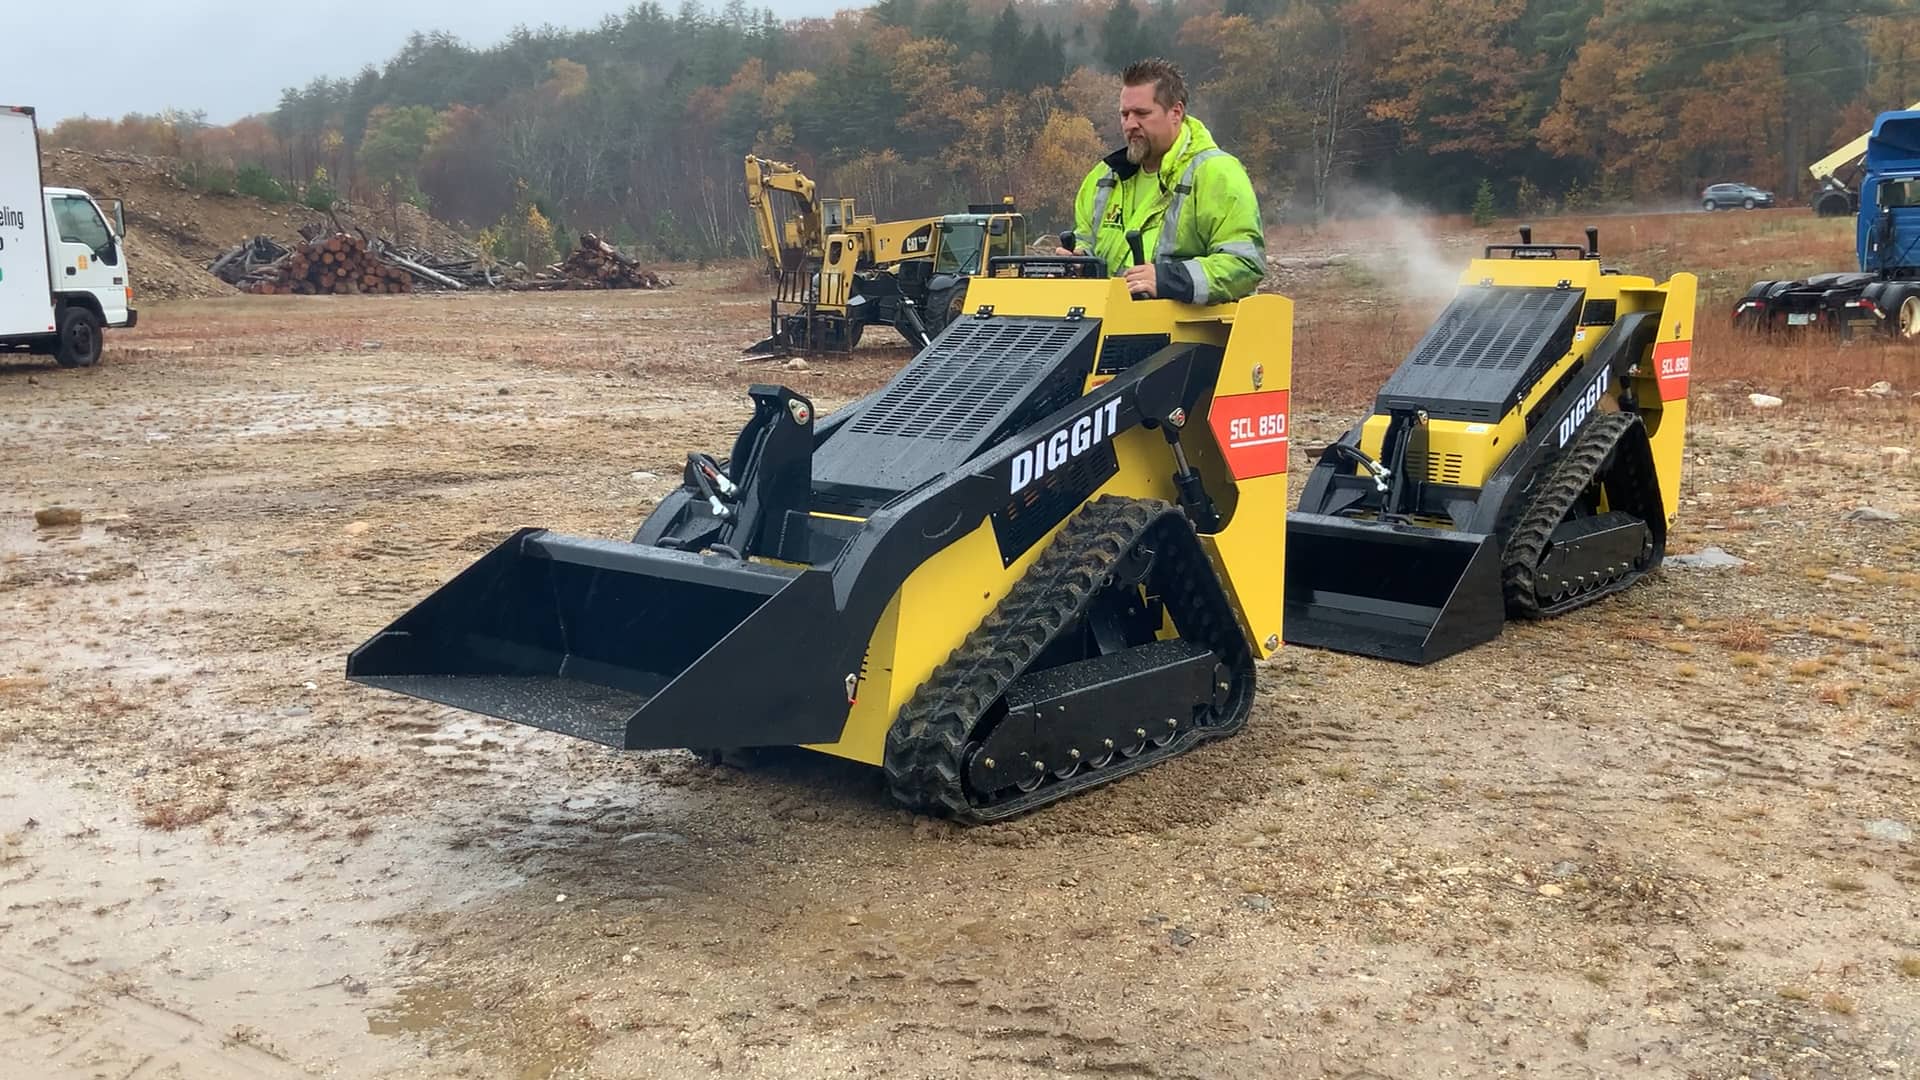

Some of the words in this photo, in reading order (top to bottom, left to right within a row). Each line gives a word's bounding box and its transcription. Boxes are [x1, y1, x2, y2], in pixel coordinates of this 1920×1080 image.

[1010, 395, 1122, 495] DIGGIT
[1230, 417, 1255, 440] SCL
[1259, 413, 1285, 437] 850
[1559, 363, 1610, 448] DIGGIT
